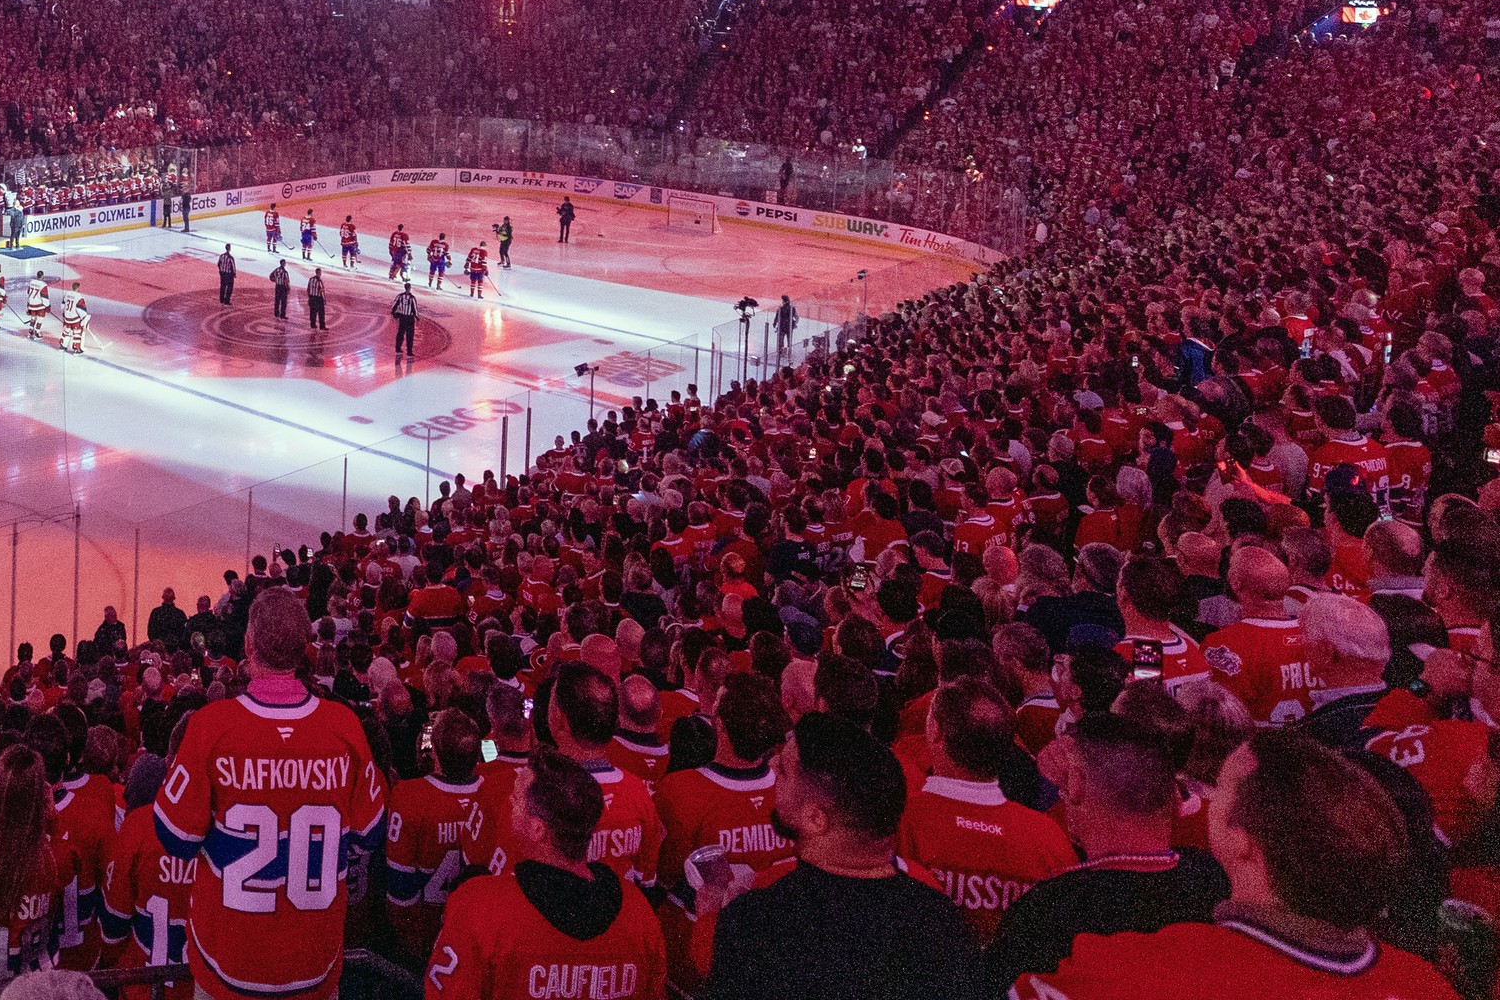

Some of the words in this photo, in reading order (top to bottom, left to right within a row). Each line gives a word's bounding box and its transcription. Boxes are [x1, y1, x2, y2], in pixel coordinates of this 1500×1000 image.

[391, 170, 438, 184] Energizer
[498, 176, 519, 185] PFK
[522, 178, 542, 187] PFK
[546, 180, 567, 189] PFK
[574, 178, 598, 192] SAP
[295, 182, 327, 193] CFMOTO
[614, 183, 636, 198] SAP
[192, 197, 217, 211] Eats
[226, 191, 242, 206] Bell
[98, 208, 136, 223] OLYMEL
[756, 206, 798, 222] PEPSI
[812, 214, 886, 236] SUBWAY
[900, 228, 921, 247] Tim
[365, 761, 381, 802] 2
[388, 812, 402, 842] 8
[956, 816, 1003, 836] Reebok
[587, 825, 642, 862] UTSON
[223, 803, 342, 912] 20
[429, 945, 459, 991] 2
[529, 963, 638, 1000] CAUFIELD
